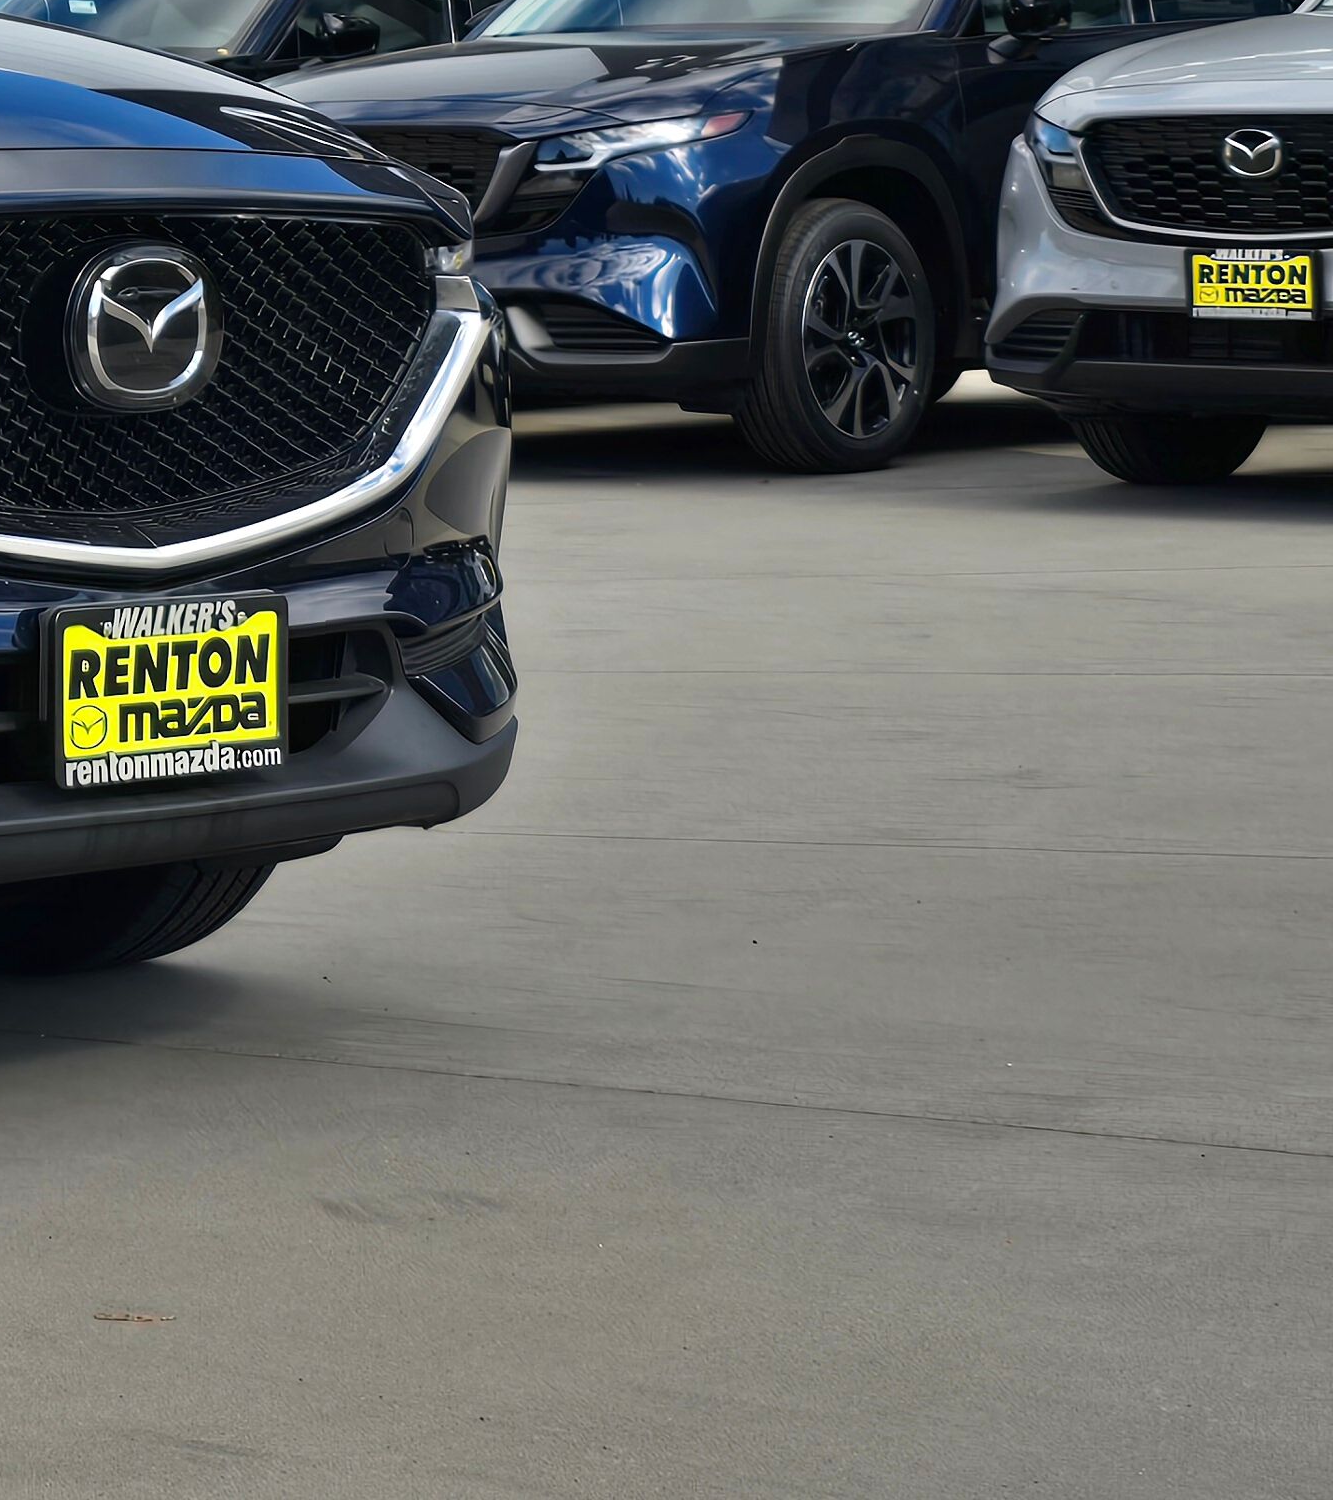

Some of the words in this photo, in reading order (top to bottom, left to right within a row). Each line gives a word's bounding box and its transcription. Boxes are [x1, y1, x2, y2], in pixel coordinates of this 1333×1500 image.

[1198, 263, 1307, 286] RENTON
[112, 600, 237, 639] WALKER'S
[68, 634, 270, 700] RENTON
[65, 741, 282, 786] rentonmazda.com
